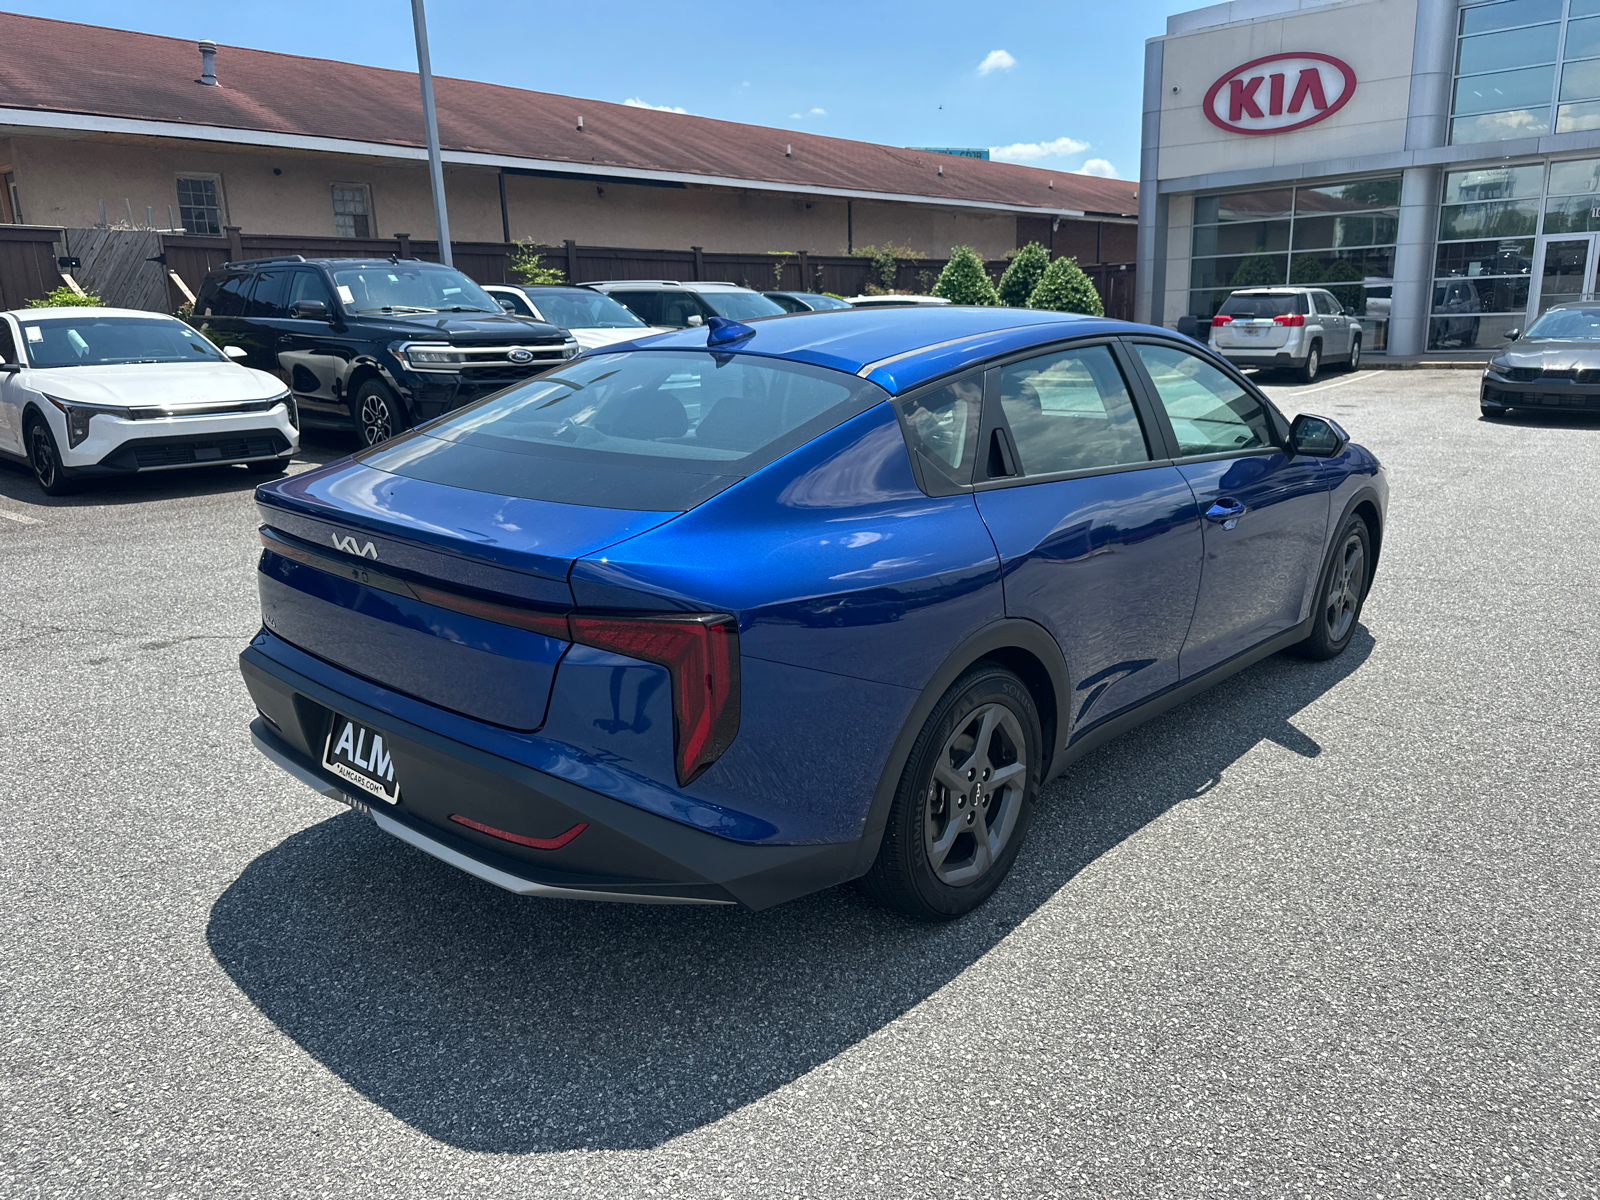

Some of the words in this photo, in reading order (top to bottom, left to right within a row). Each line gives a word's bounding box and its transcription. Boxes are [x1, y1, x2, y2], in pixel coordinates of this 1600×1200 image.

[1228, 67, 1328, 122] KIA
[331, 532, 379, 560] KIA
[1002, 683, 1033, 714] SOLUS
[334, 721, 395, 782] ALM
[914, 790, 925, 867] KUMHO
